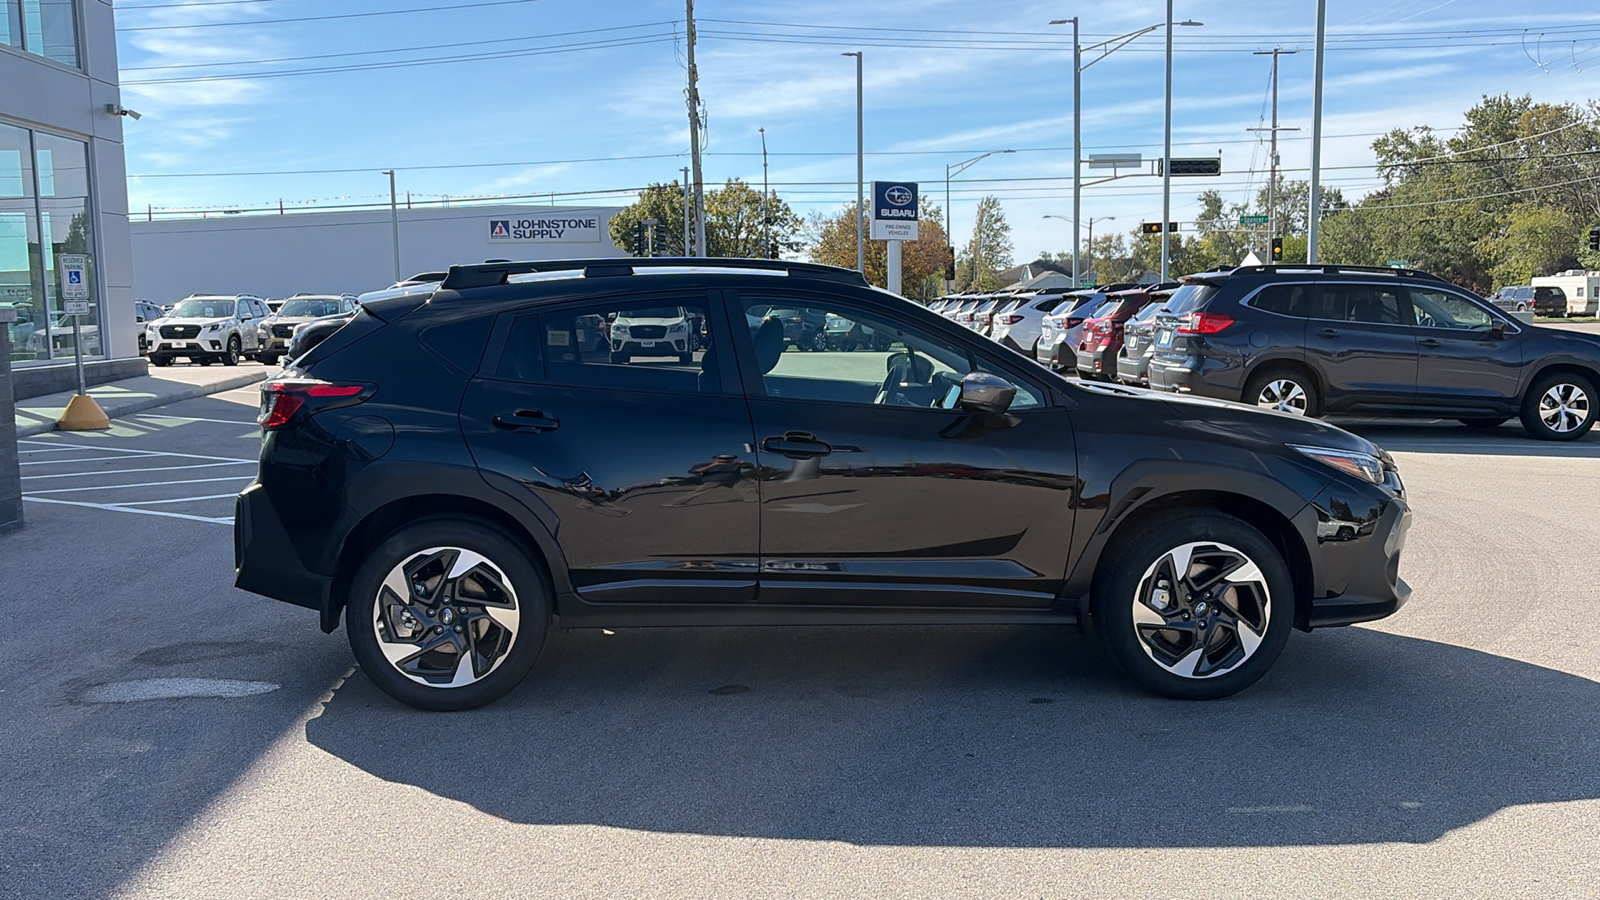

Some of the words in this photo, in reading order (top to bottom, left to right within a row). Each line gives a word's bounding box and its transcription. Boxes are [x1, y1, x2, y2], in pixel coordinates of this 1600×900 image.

[881, 208, 916, 218] SUBARU
[512, 219, 597, 230] JOHNSTONE
[1243, 216, 1264, 224] Spencer
[513, 229, 565, 239] SUPPLY
